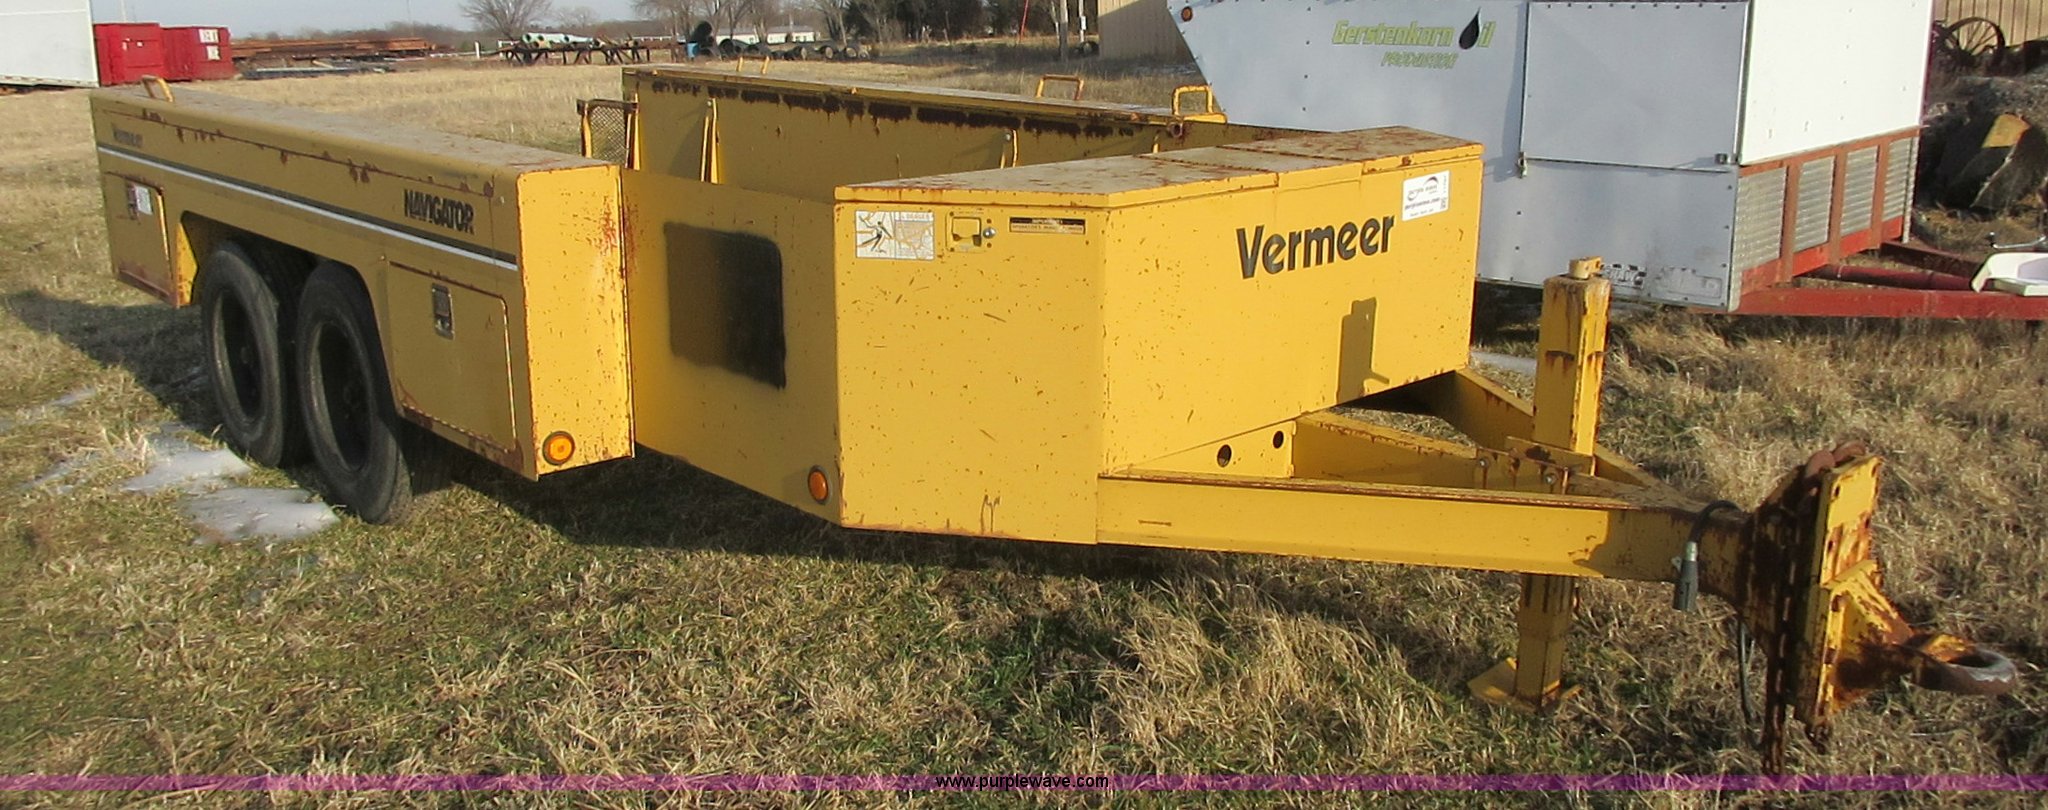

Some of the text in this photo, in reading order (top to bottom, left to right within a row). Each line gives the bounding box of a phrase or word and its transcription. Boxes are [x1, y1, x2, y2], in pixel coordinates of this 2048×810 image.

[1332, 20, 1455, 47] Gerstenkorn
[404, 189, 475, 235] NAVIGATOR
[1236, 215, 1395, 280] Vermeer
